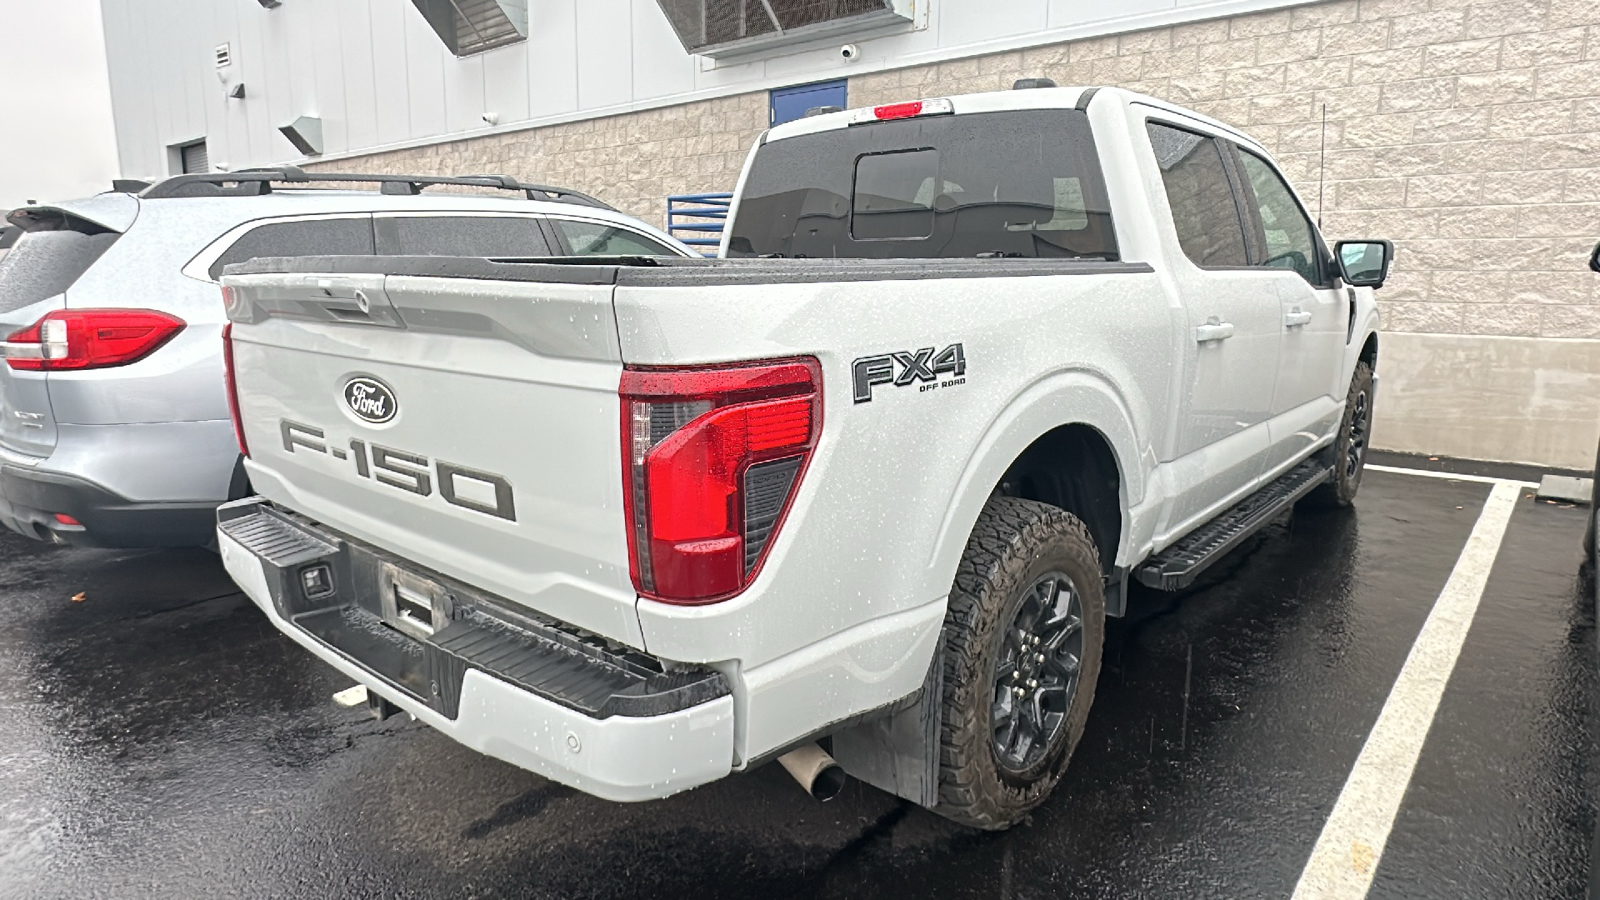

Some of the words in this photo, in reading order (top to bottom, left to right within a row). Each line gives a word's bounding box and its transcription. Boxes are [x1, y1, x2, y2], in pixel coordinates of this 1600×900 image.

[851, 343, 966, 405] FX4
[919, 382, 939, 393] OFF
[941, 377, 966, 389] ROAD
[351, 382, 386, 416] Ford
[280, 418, 518, 523] F-150
